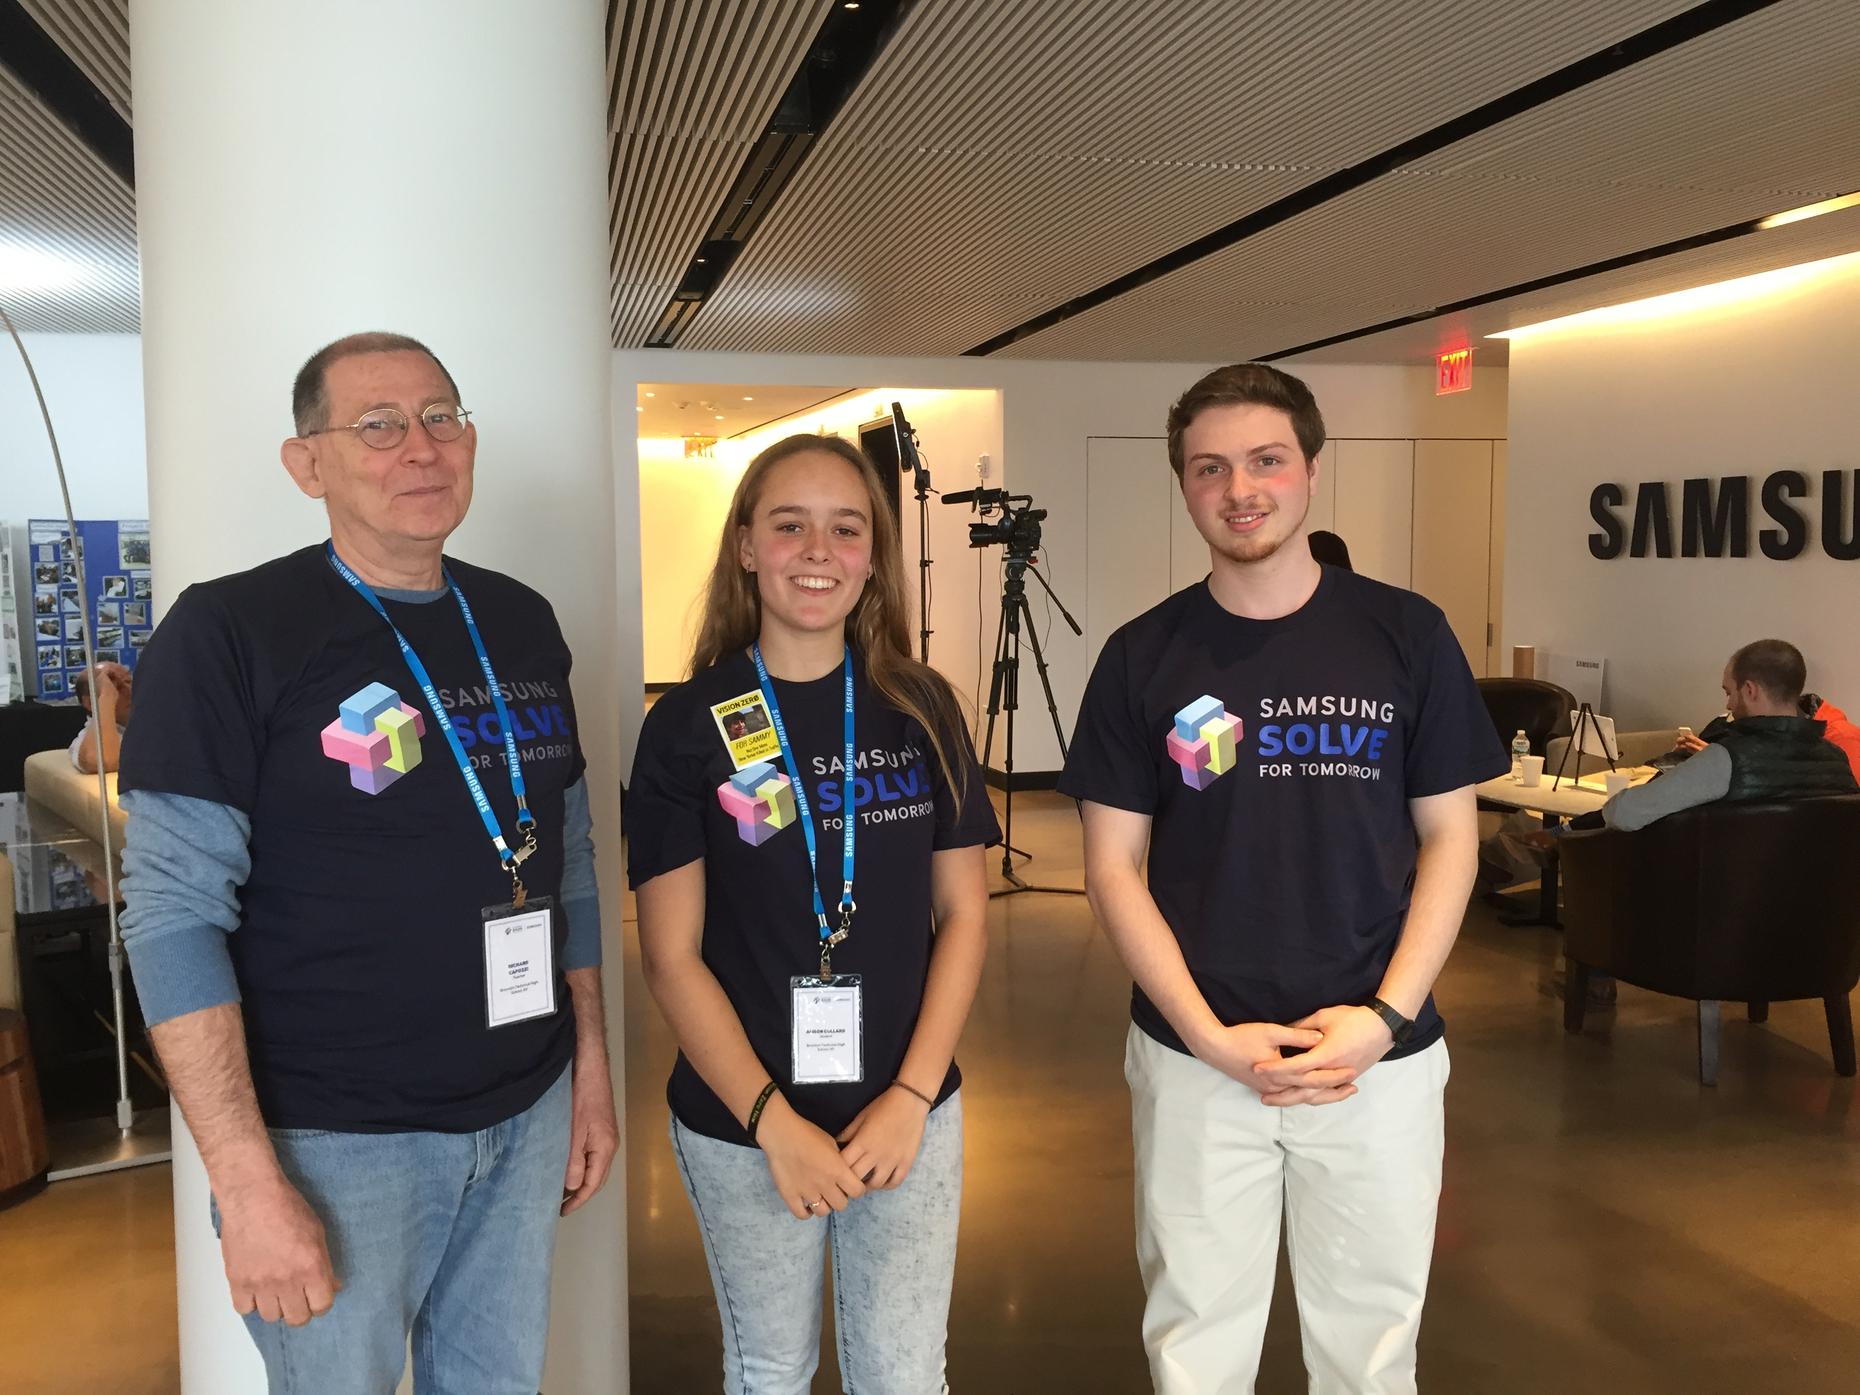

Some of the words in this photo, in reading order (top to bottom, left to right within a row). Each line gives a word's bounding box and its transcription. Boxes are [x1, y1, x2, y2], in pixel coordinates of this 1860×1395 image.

[1441, 350, 1468, 388] EXIT
[331, 554, 361, 586] SAMSUNG
[453, 586, 474, 624] SAMSUNG
[481, 656, 501, 697] SAMSUNG
[754, 648, 768, 681] SAMSUNG
[423, 685, 451, 731] SAMSUNG
[439, 681, 558, 709] SAMSUNG
[717, 702, 741, 714] VISION
[845, 677, 853, 713] SAMSUNG
[1259, 695, 1395, 723] SAMSUNG
[748, 731, 771, 745] SAMMY
[771, 709, 788, 747] SAMSUNG
[1258, 723, 1389, 760] SOLVE
[467, 755, 493, 769] OR
[505, 732, 520, 778] SAMSUNG
[812, 744, 920, 775] SAMSUN
[1259, 764, 1292, 777] FOR
[1299, 762, 1381, 781] TOMORROW
[463, 766, 490, 813] SAMSUNG
[792, 776, 810, 816] SAMSUNG
[822, 818, 843, 831] FO
[845, 814, 853, 857] SAMSUNG
